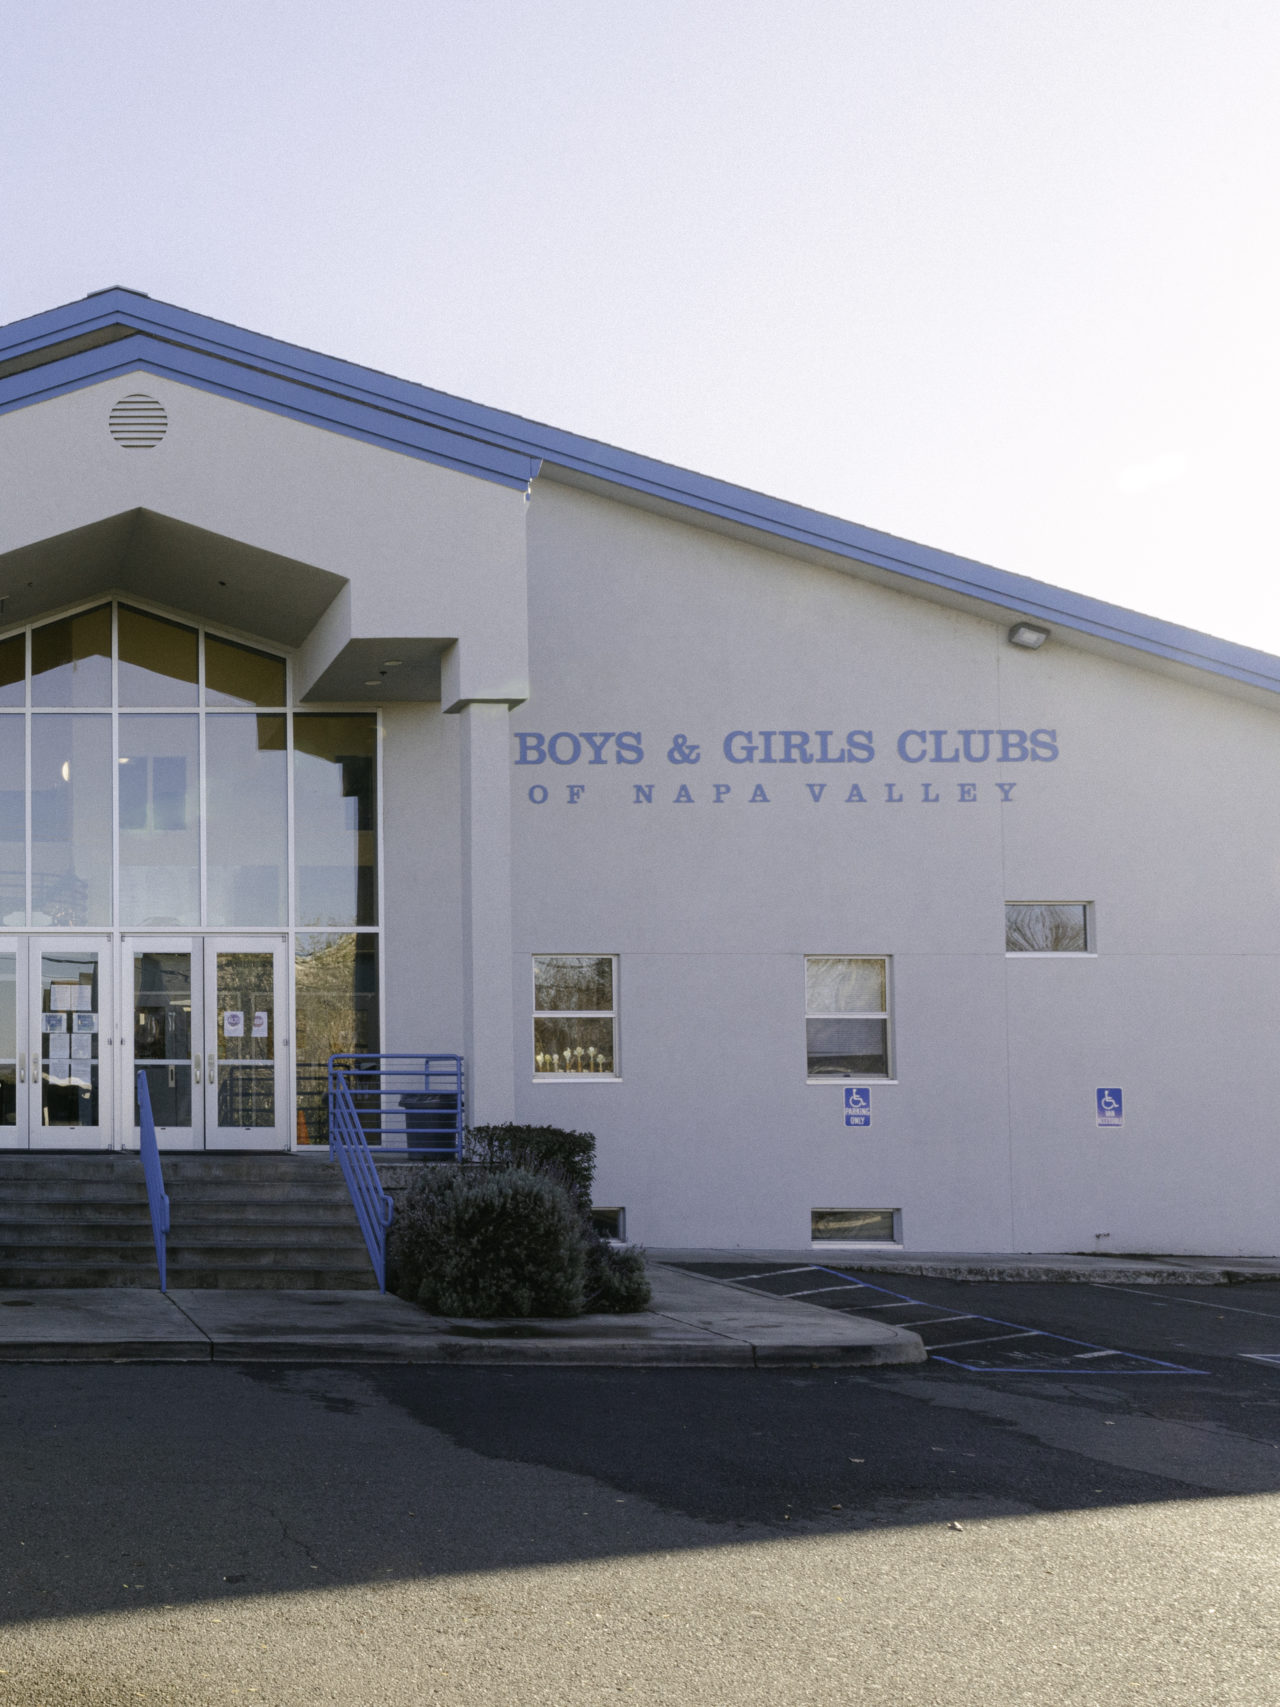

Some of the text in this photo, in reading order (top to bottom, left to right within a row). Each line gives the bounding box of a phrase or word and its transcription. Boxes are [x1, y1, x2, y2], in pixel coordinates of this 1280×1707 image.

[514, 729, 1059, 765] BOYS & GIRLS CLUBS
[528, 782, 1016, 805] OF NAPA VALLEY
